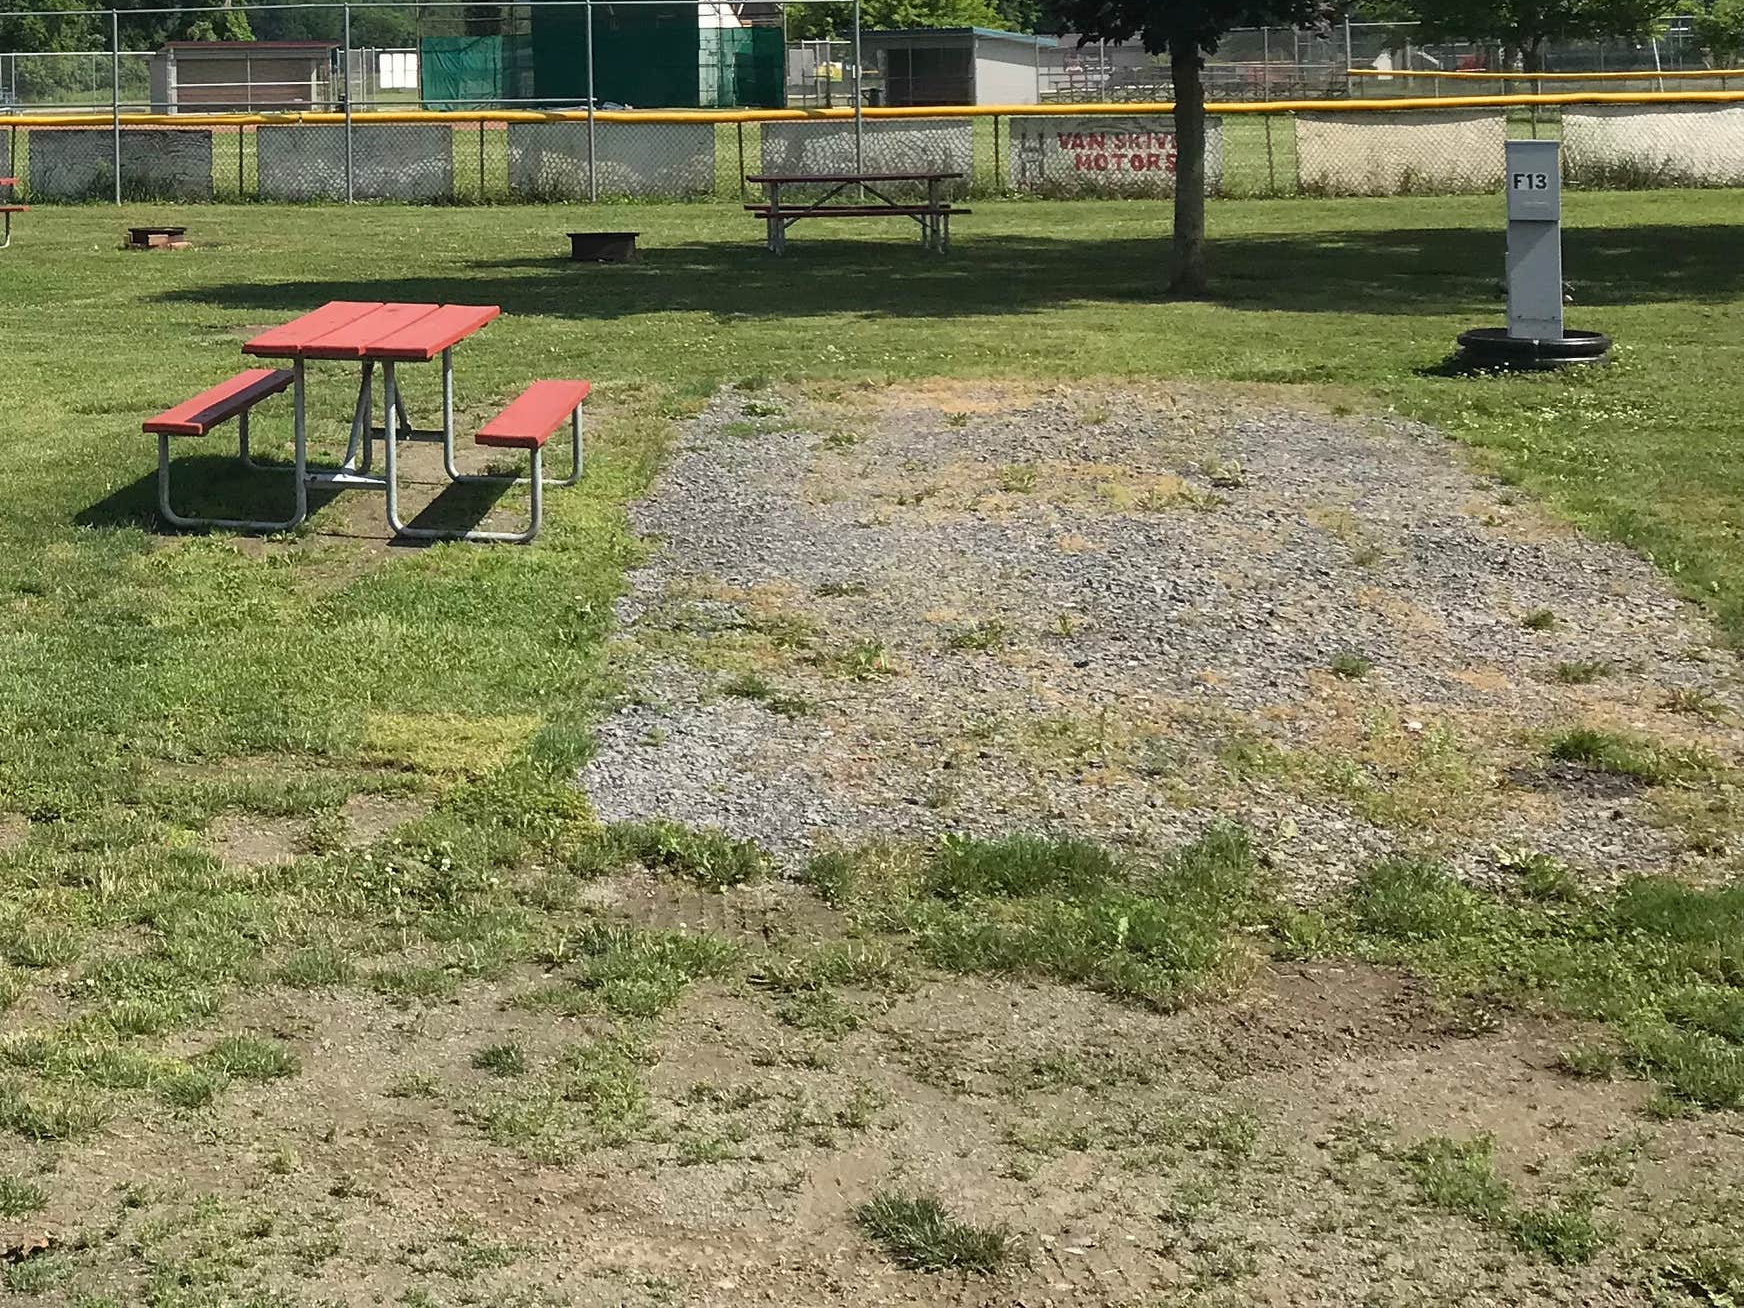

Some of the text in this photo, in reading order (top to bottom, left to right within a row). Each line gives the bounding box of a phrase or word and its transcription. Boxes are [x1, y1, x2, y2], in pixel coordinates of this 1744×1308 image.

[1057, 132, 1106, 150] VAN
[1074, 153, 1178, 172] MOTORS
[1513, 173, 1548, 190] F13
